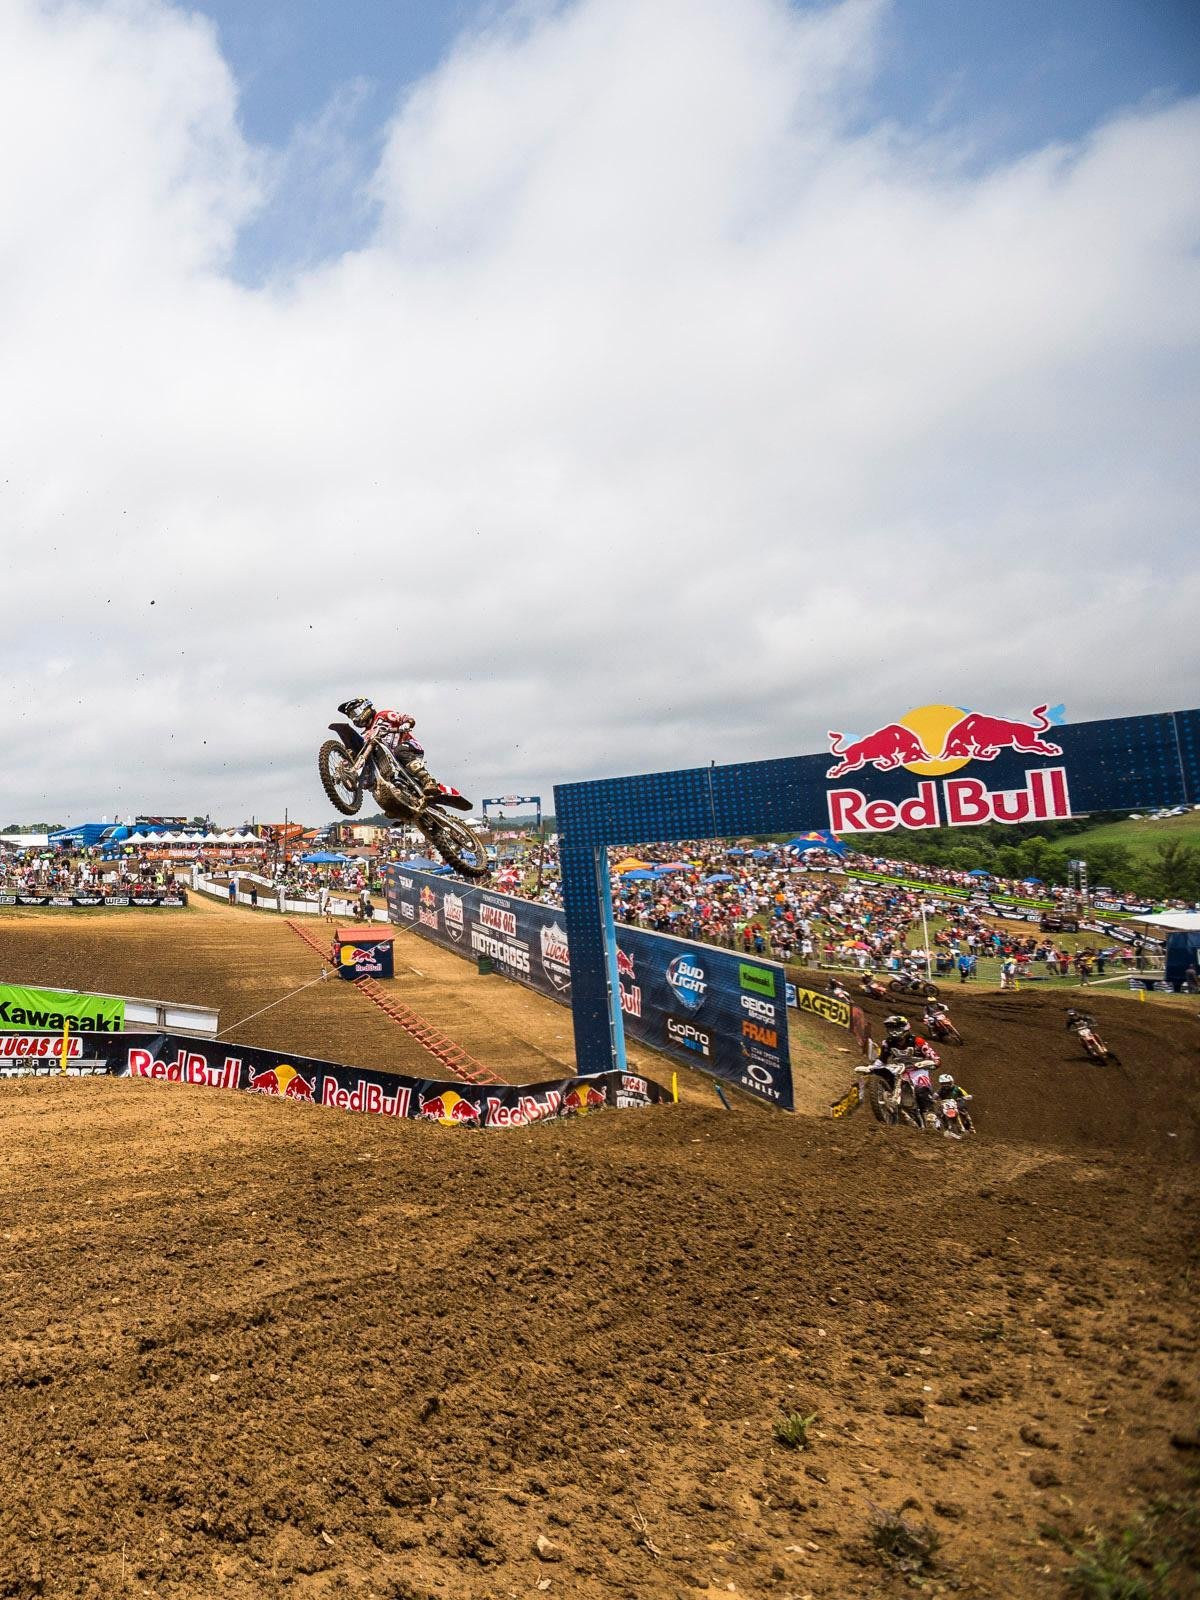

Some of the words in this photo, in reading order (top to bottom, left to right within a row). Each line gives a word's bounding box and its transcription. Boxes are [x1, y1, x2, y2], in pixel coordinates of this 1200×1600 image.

[827, 781, 940, 834] Red
[943, 767, 1071, 827] Bull
[104, 896, 130, 906] WPS
[481, 905, 501, 930] LUCAS
[502, 913, 515, 934] OIL
[471, 930, 530, 973] MOTOCROSS
[545, 942, 569, 964] LUCAS
[672, 972, 708, 994] LIGHT
[678, 961, 704, 980] BUD
[740, 995, 775, 1017] GEICO
[667, 1018, 710, 1046] GoPro
[741, 1019, 778, 1049] FRAM
[51, 1037, 81, 1057] OIL
[128, 1048, 186, 1082] Red
[186, 1052, 242, 1089] Bull
[322, 1076, 366, 1111] Red
[365, 1083, 413, 1118] Bull
[741, 1075, 781, 1100] OAKLEY
[485, 1096, 528, 1127] Red
[523, 1090, 562, 1122] Bull
